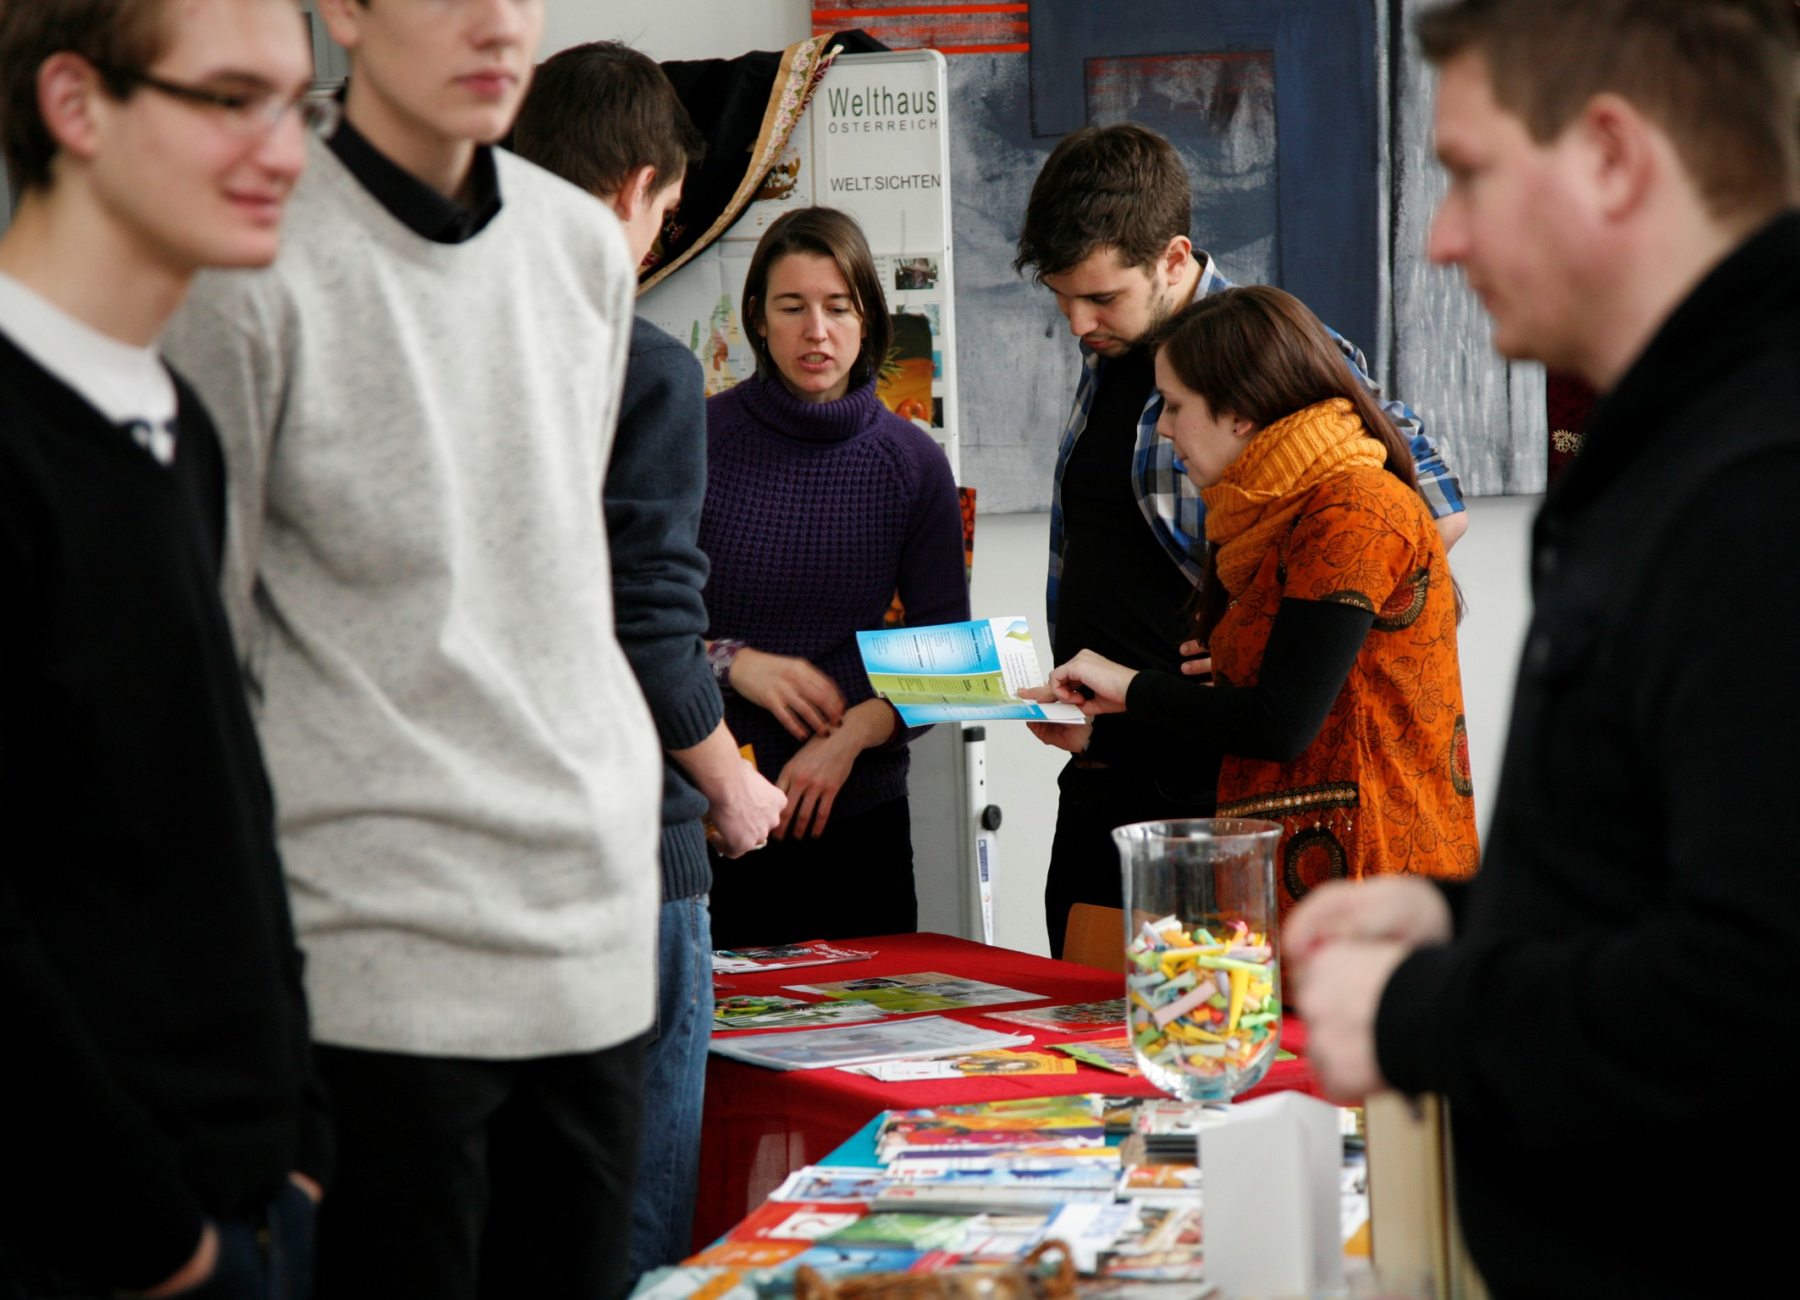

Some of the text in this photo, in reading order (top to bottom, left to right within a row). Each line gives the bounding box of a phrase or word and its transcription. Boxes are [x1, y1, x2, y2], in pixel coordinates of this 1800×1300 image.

[828, 86, 937, 117] Welthaus
[829, 119, 938, 134] ÖSTERREICH
[830, 174, 941, 191] WELT.SICHTEN
